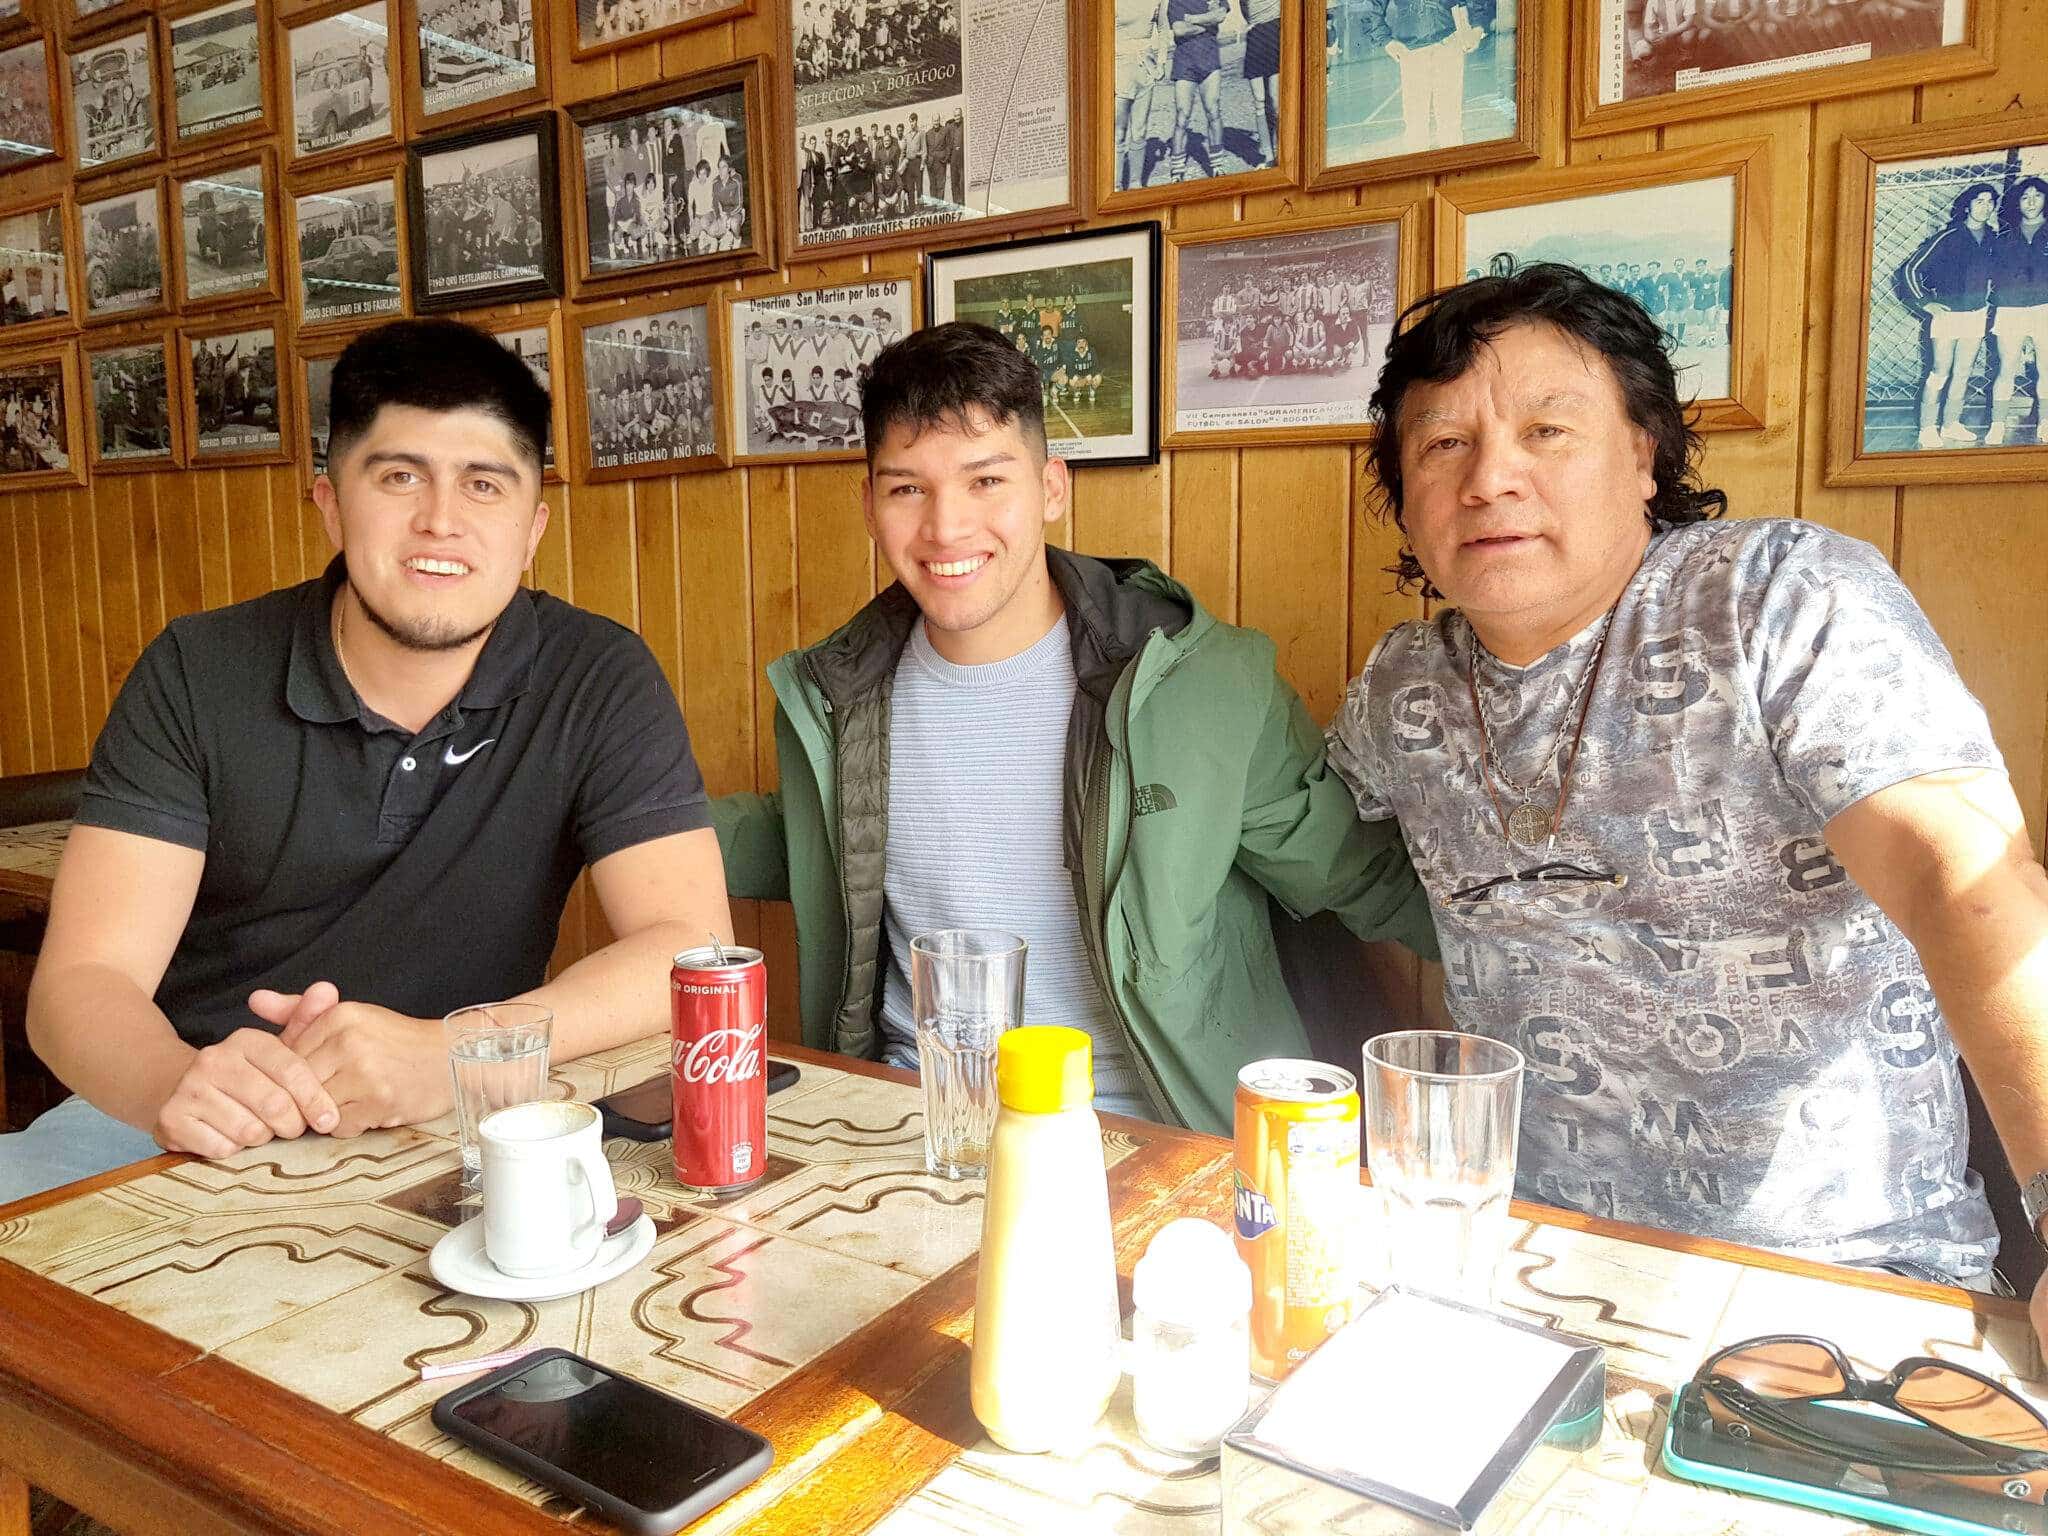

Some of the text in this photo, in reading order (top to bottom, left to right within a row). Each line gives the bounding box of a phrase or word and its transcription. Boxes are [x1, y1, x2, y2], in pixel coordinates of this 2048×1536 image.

[872, 79, 880, 94] Y
[887, 63, 956, 92] BOTAFOGO
[802, 211, 963, 246] BOTAFOGO DIRIGENTES FERNANDEZ
[353, 302, 361, 314] EN
[363, 301, 372, 313] SU
[750, 281, 898, 316] Deportivo San Martin por los 60
[598, 454, 619, 468] CLUB
[623, 448, 668, 465] BELGRANO
[673, 442, 692, 459] AÑO
[683, 983, 737, 995] ORIGINAL
